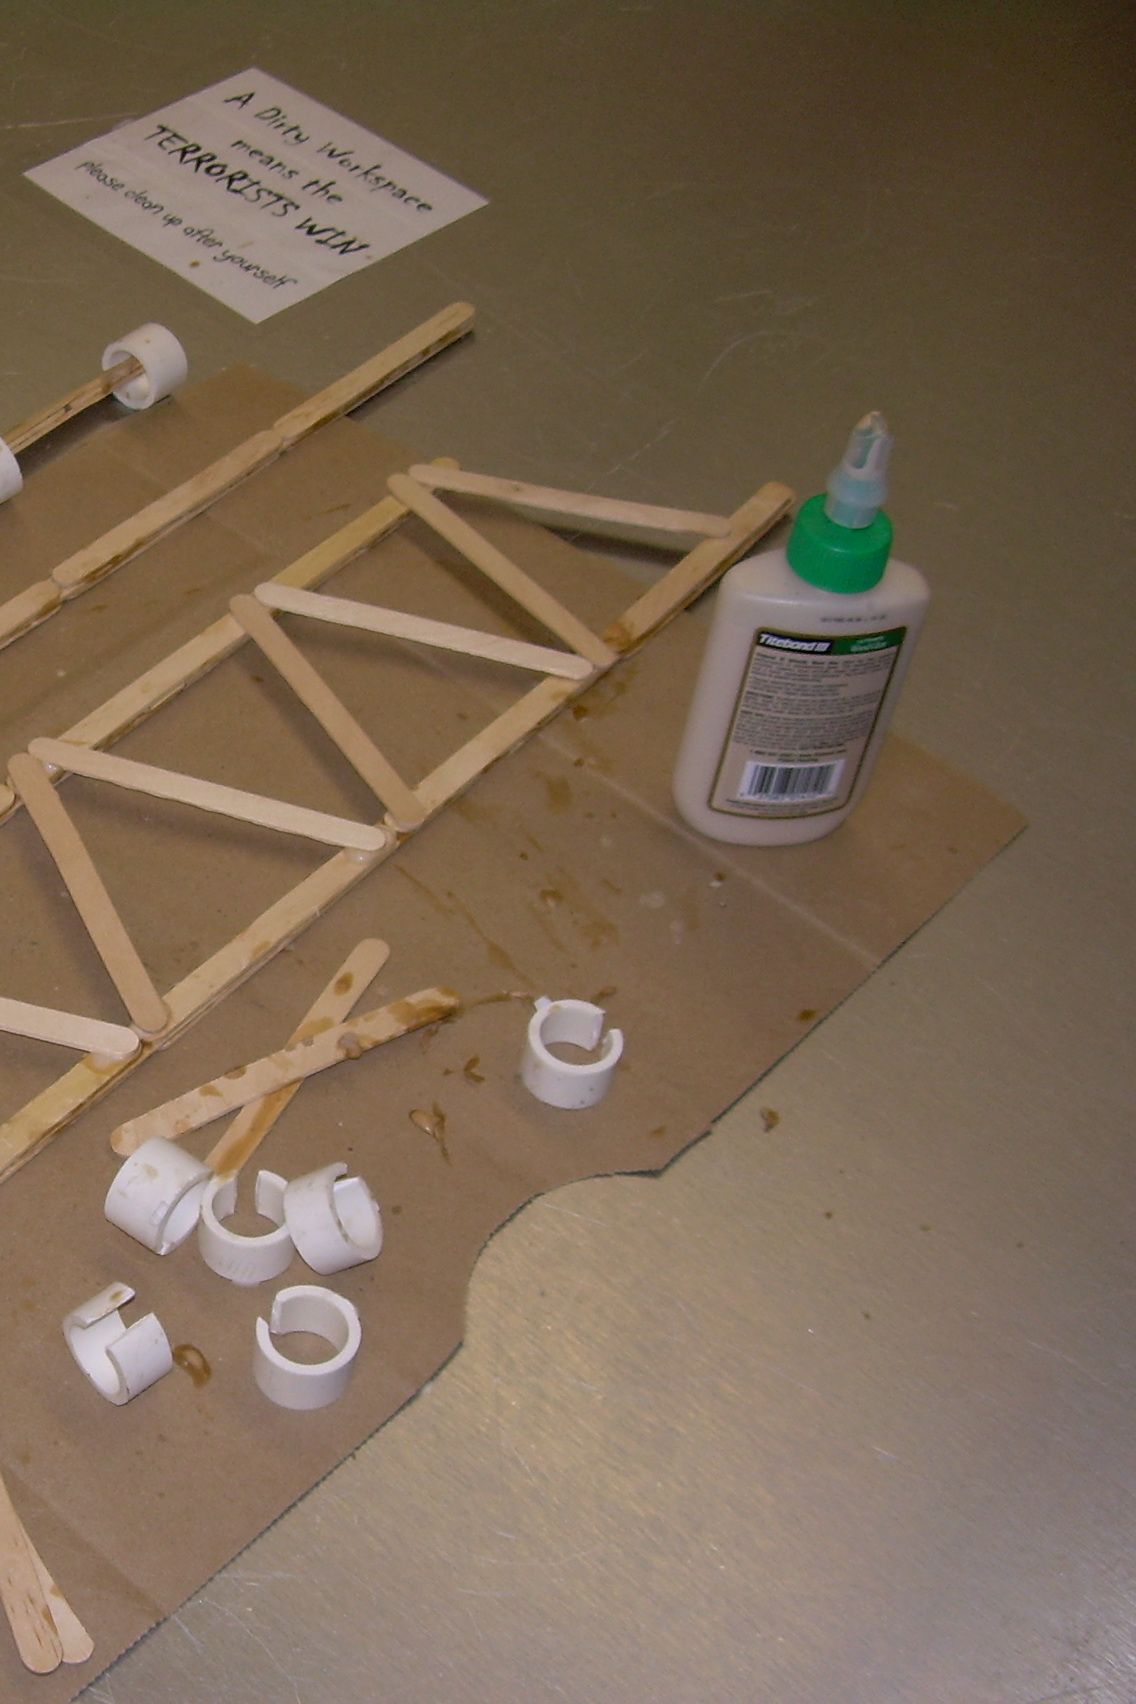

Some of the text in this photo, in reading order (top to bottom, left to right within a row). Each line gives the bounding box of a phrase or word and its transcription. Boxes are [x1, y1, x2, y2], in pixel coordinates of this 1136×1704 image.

[144, 124, 370, 255] TERRORISTS WIN
[224, 91, 433, 212] A Dirty Workspace
[231, 139, 343, 205] means the
[124, 190, 164, 214] clean
[163, 213, 183, 228] up
[183, 226, 223, 248] after
[213, 249, 297, 289] yourself
